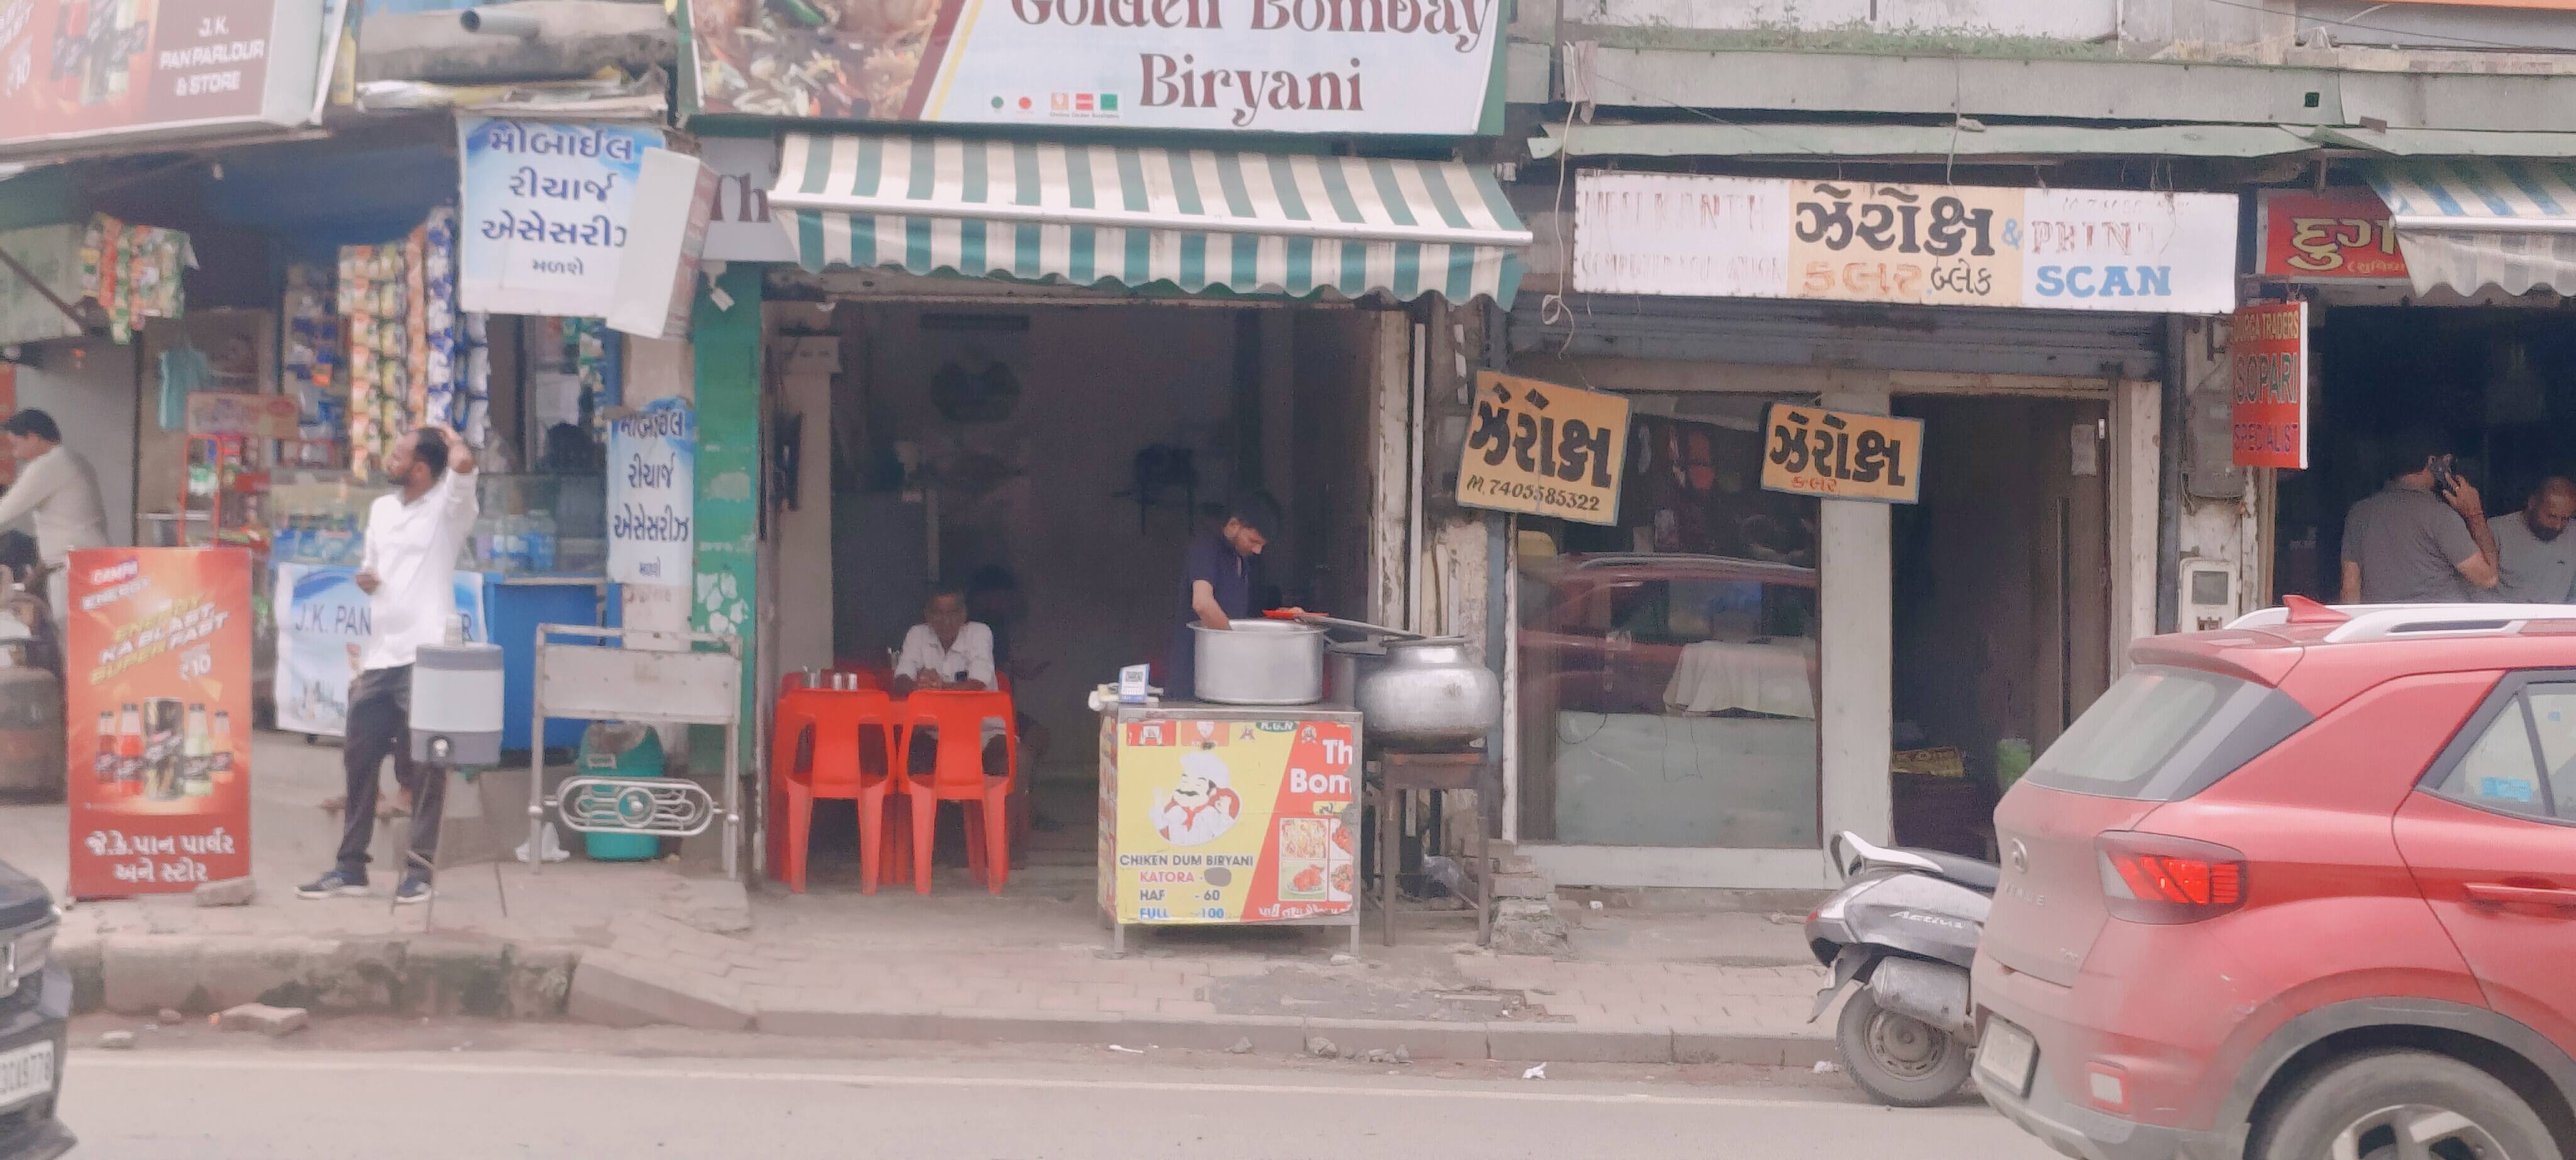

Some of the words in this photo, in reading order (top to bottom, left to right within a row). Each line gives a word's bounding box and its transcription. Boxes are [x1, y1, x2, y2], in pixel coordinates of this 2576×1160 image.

[1250, 0, 1492, 53] Bombay
[1139, 53, 1363, 126] Biryani
[2035, 265, 2172, 298] SCAN
[2262, 311, 2299, 340] TRADERS
[2235, 352, 2297, 404] SOPARI
[1468, 381, 1612, 489] ઝેરોક્ષ
[1770, 411, 1906, 486] ઝેરોક્ષ
[335, 605, 372, 635] PAN
[113, 857, 156, 883] અને
[1119, 854, 1168, 866] CHIKEN
[1172, 855, 1202, 866] DUM
[1206, 855, 1253, 866] BIRYANI
[1140, 871, 1194, 883] KATORA
[1140, 890, 1165, 901] HAF
[1204, 890, 1220, 901] 60
[1140, 908, 1168, 919] FULL
